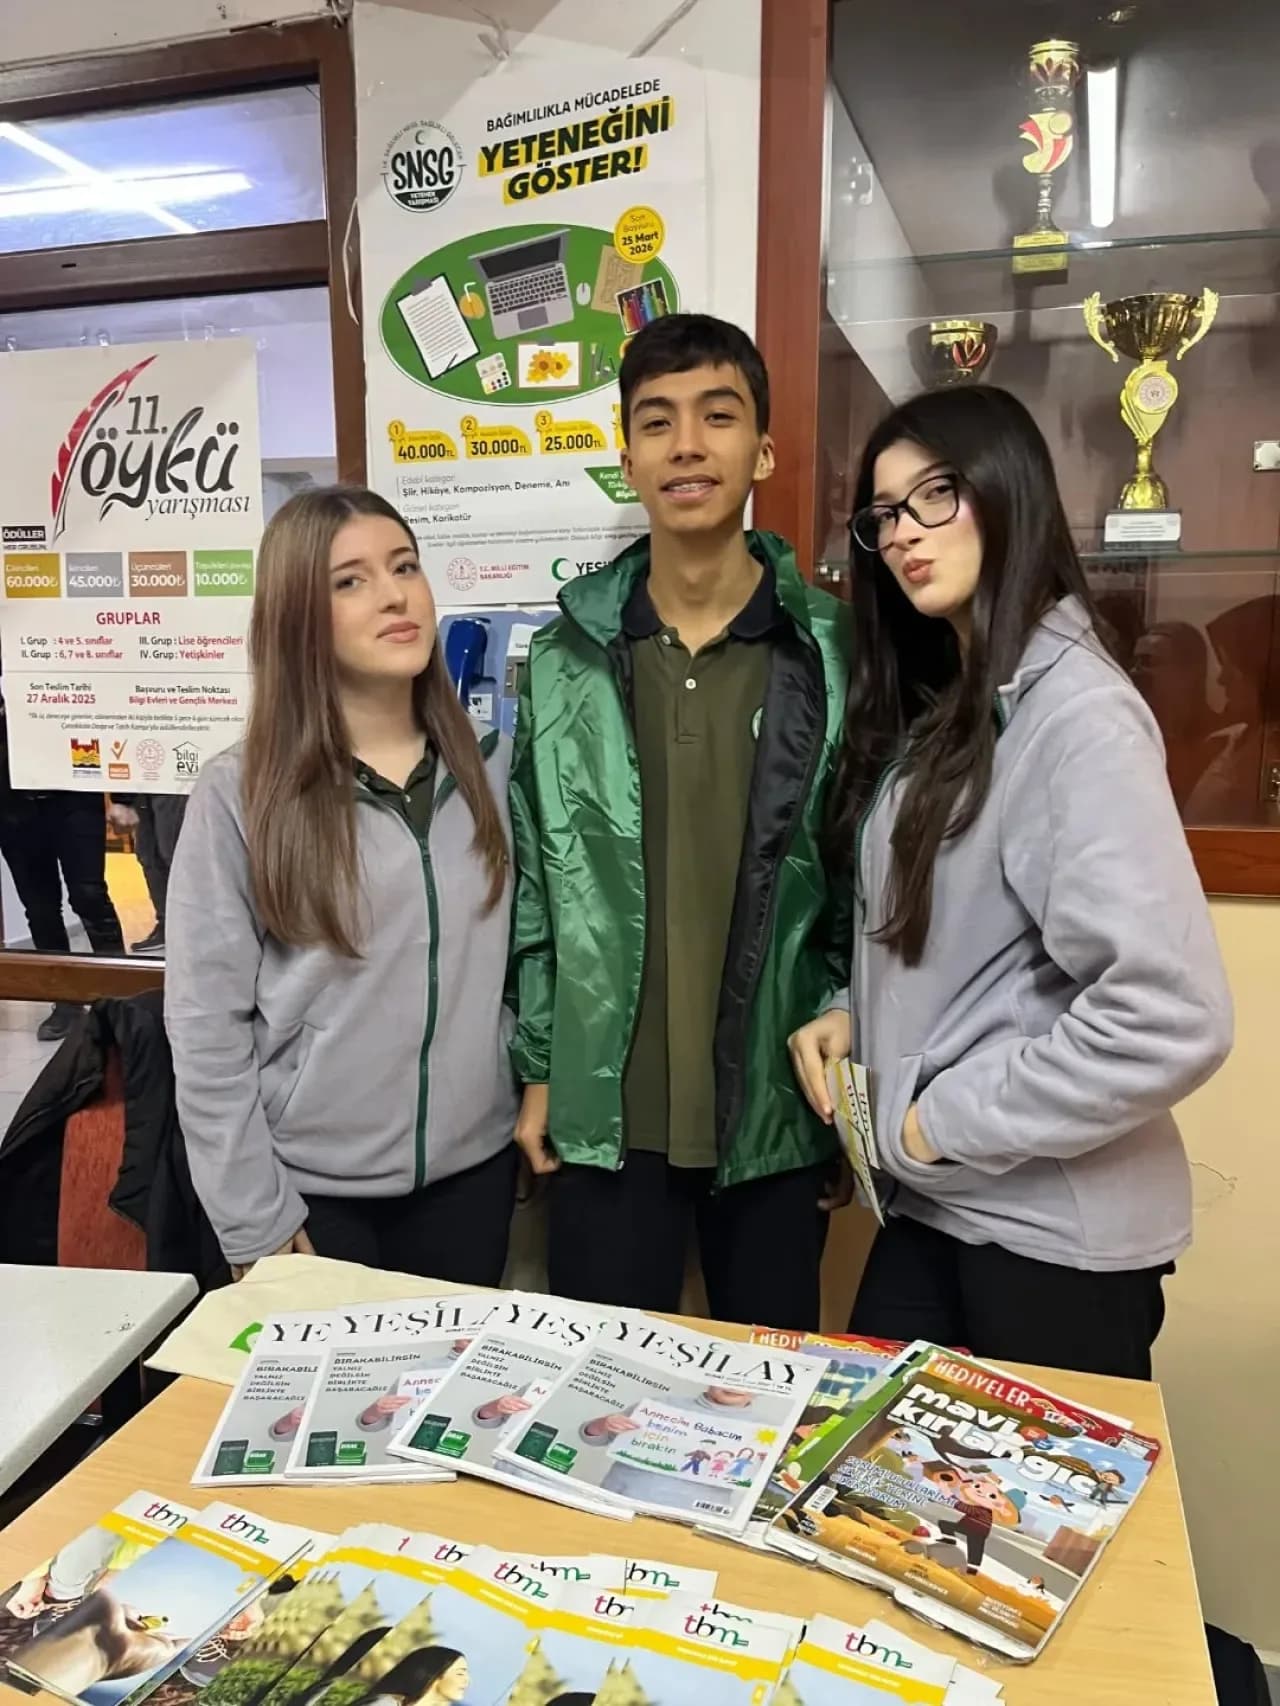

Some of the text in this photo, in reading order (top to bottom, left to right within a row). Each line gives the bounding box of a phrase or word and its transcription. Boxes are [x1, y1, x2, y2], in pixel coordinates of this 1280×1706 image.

[487, 79, 661, 132] BAĞIMLILIKLA MÜCADELEDE
[481, 96, 670, 172] YETENEĞİNİ
[391, 146, 454, 190] SNSG
[508, 147, 643, 200] GÖSTER!
[621, 231, 659, 246] 25 Mart
[629, 243, 654, 255] 2026
[126, 395, 168, 435] 11.
[540, 415, 547, 426] 3
[465, 420, 473, 430] 2
[81, 407, 239, 522] öykü
[144, 495, 250, 522] yarışması
[433, 513, 472, 524] Karikatür
[3, 528, 44, 539] ÖDÜLLER
[96, 612, 161, 625] GRUPLAR
[27, 636, 48, 647] Grup
[151, 636, 172, 647] Grup
[178, 636, 195, 645] Lise
[30, 650, 51, 660] Grup
[153, 650, 174, 661] Grup
[180, 650, 225, 661] Yetişkinler
[26, 693, 96, 704] 27 Aralık 2025
[616, 1321, 811, 1385] YEŞİLAY
[905, 1383, 1021, 1434] mavi
[434, 1544, 470, 1563] tb
[594, 1595, 635, 1617] tb
[683, 1615, 749, 1646] tbm
[844, 1632, 913, 1669] tbm
